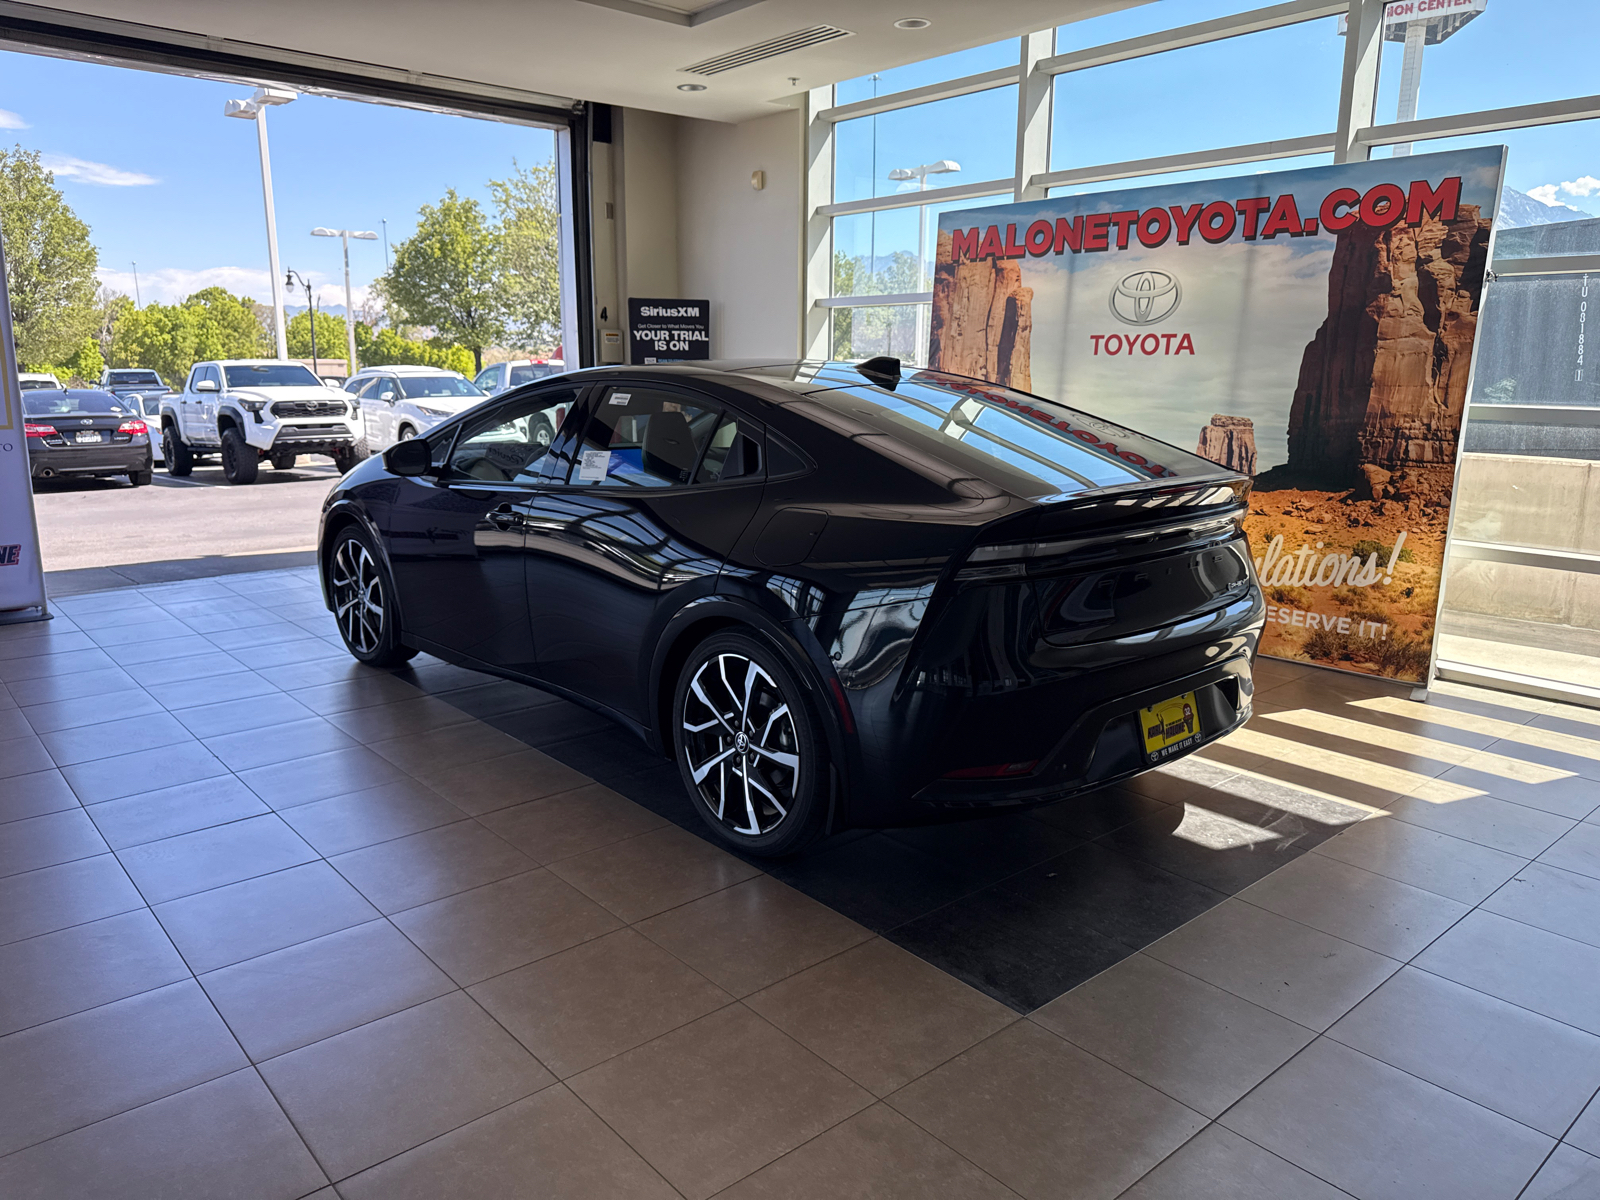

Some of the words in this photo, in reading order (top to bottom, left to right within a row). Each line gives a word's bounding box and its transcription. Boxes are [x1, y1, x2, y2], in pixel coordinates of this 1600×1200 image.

[951, 177, 1462, 260] MALONETOYOTA.COM
[600, 306, 608, 322] 4
[640, 306, 700, 317] SiriusXM
[633, 330, 669, 341] YOUR
[672, 330, 709, 341] TRIAL
[1577, 301, 1587, 366] 081884
[654, 341, 668, 351] IS
[670, 341, 689, 351] ON
[1090, 333, 1196, 356] TOYOTA
[1358, 621, 1388, 641] IT!
[1184, 707, 1191, 716] 32
[1161, 749, 1168, 757] WE
[1168, 744, 1179, 754] MAKE
[1183, 738, 1193, 748] EASY
